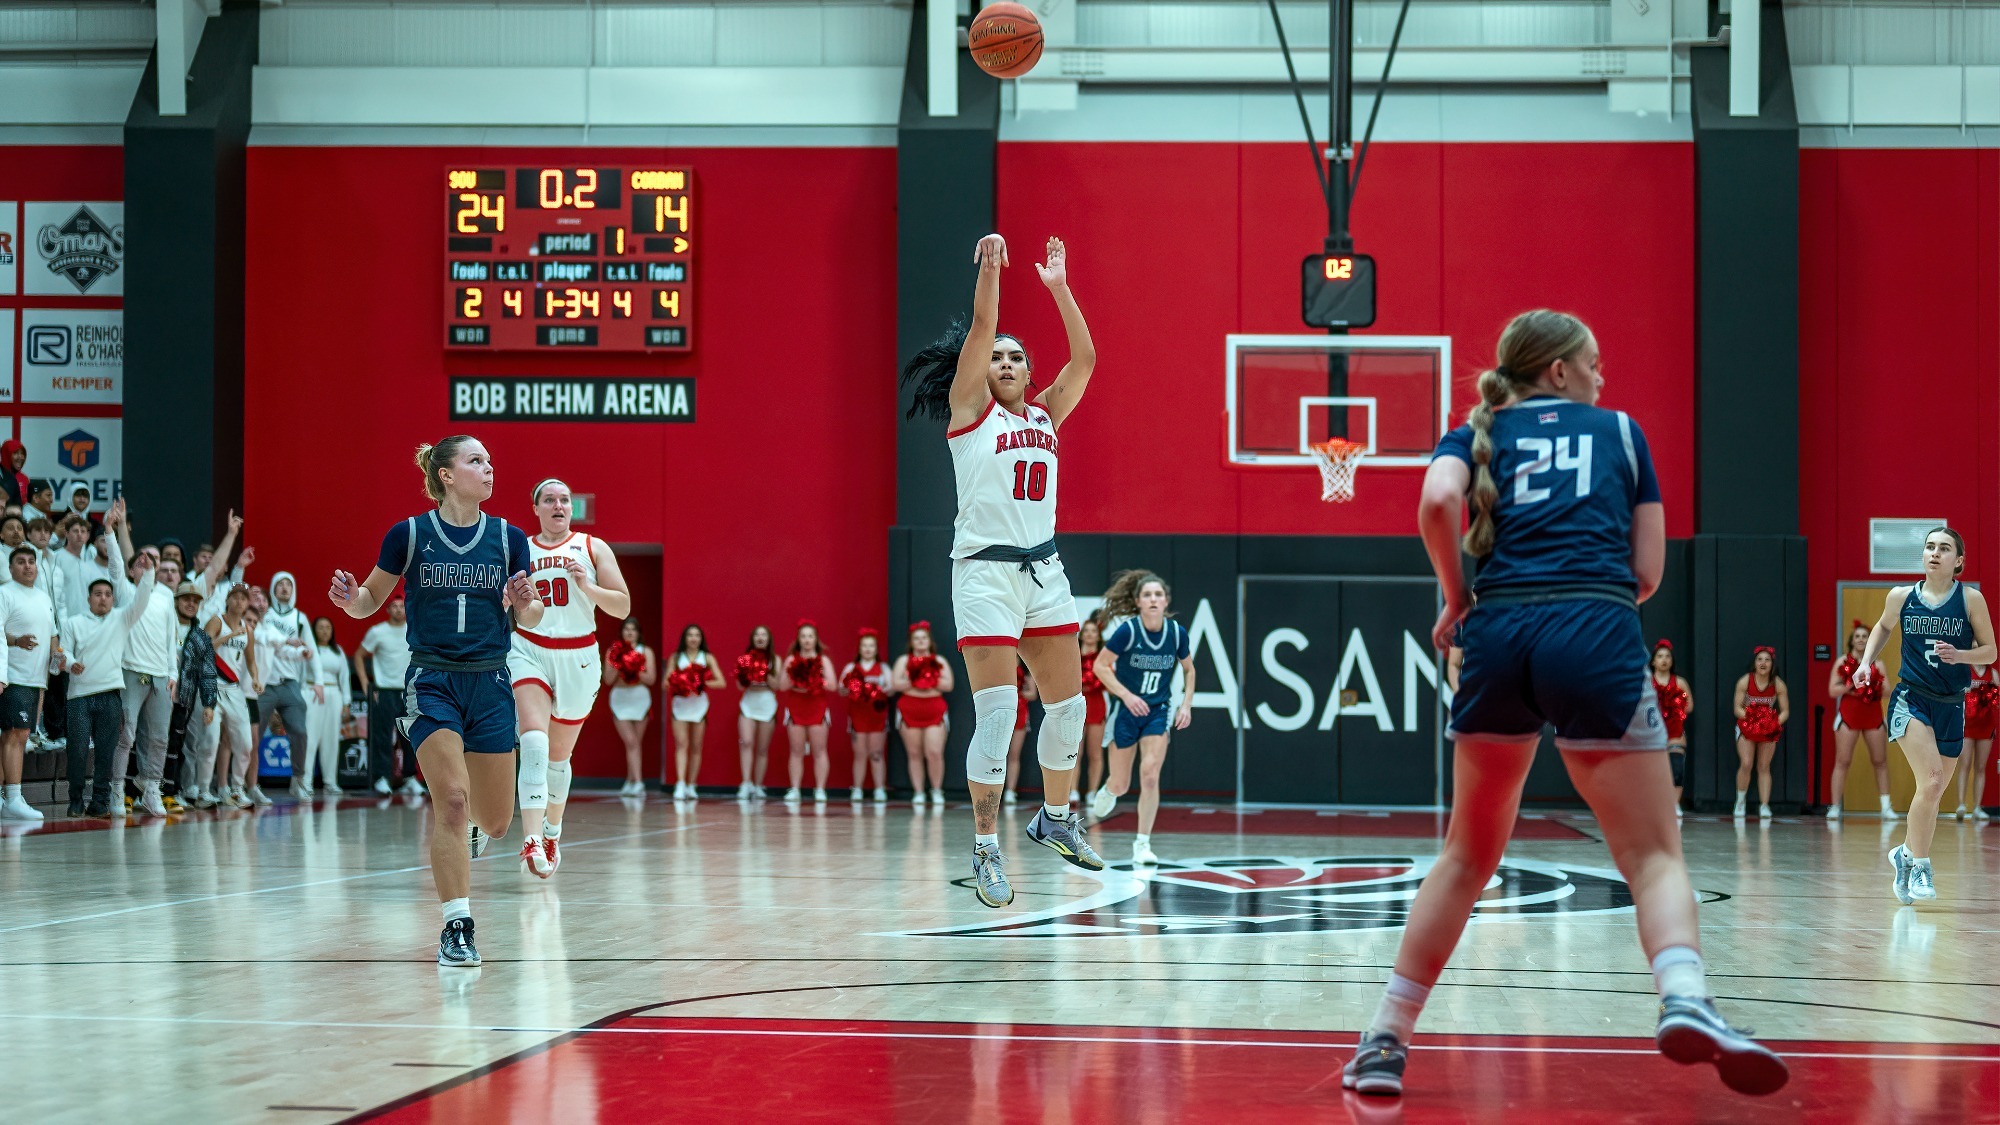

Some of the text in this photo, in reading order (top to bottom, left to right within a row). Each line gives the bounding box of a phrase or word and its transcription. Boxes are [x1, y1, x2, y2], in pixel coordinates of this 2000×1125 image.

[449, 170, 477, 189] SOU
[540, 169, 597, 209] 0.2
[457, 193, 505, 233] 24
[655, 195, 688, 232] 14
[545, 233, 591, 253] period
[616, 228, 624, 254] 1
[453, 262, 487, 279] fouls
[544, 261, 592, 282] player
[648, 262, 684, 280] fouls
[464, 288, 482, 318] 2
[503, 290, 522, 317] 4
[613, 290, 632, 318] 4
[660, 290, 679, 318] 4
[456, 328, 484, 341] won
[549, 327, 586, 346] game
[651, 330, 680, 343] won
[76, 344, 83, 360] &
[52, 376, 113, 390] KEMPER
[455, 383, 689, 415] BOB RIEHM ARENA
[1013, 460, 1048, 501] 10
[1514, 434, 1593, 504] 24
[420, 562, 501, 589] CORBAN
[535, 577, 569, 607] 20
[457, 593, 466, 633] 1
[1903, 615, 1963, 637] CORBAN
[1140, 671, 1162, 695] 10
